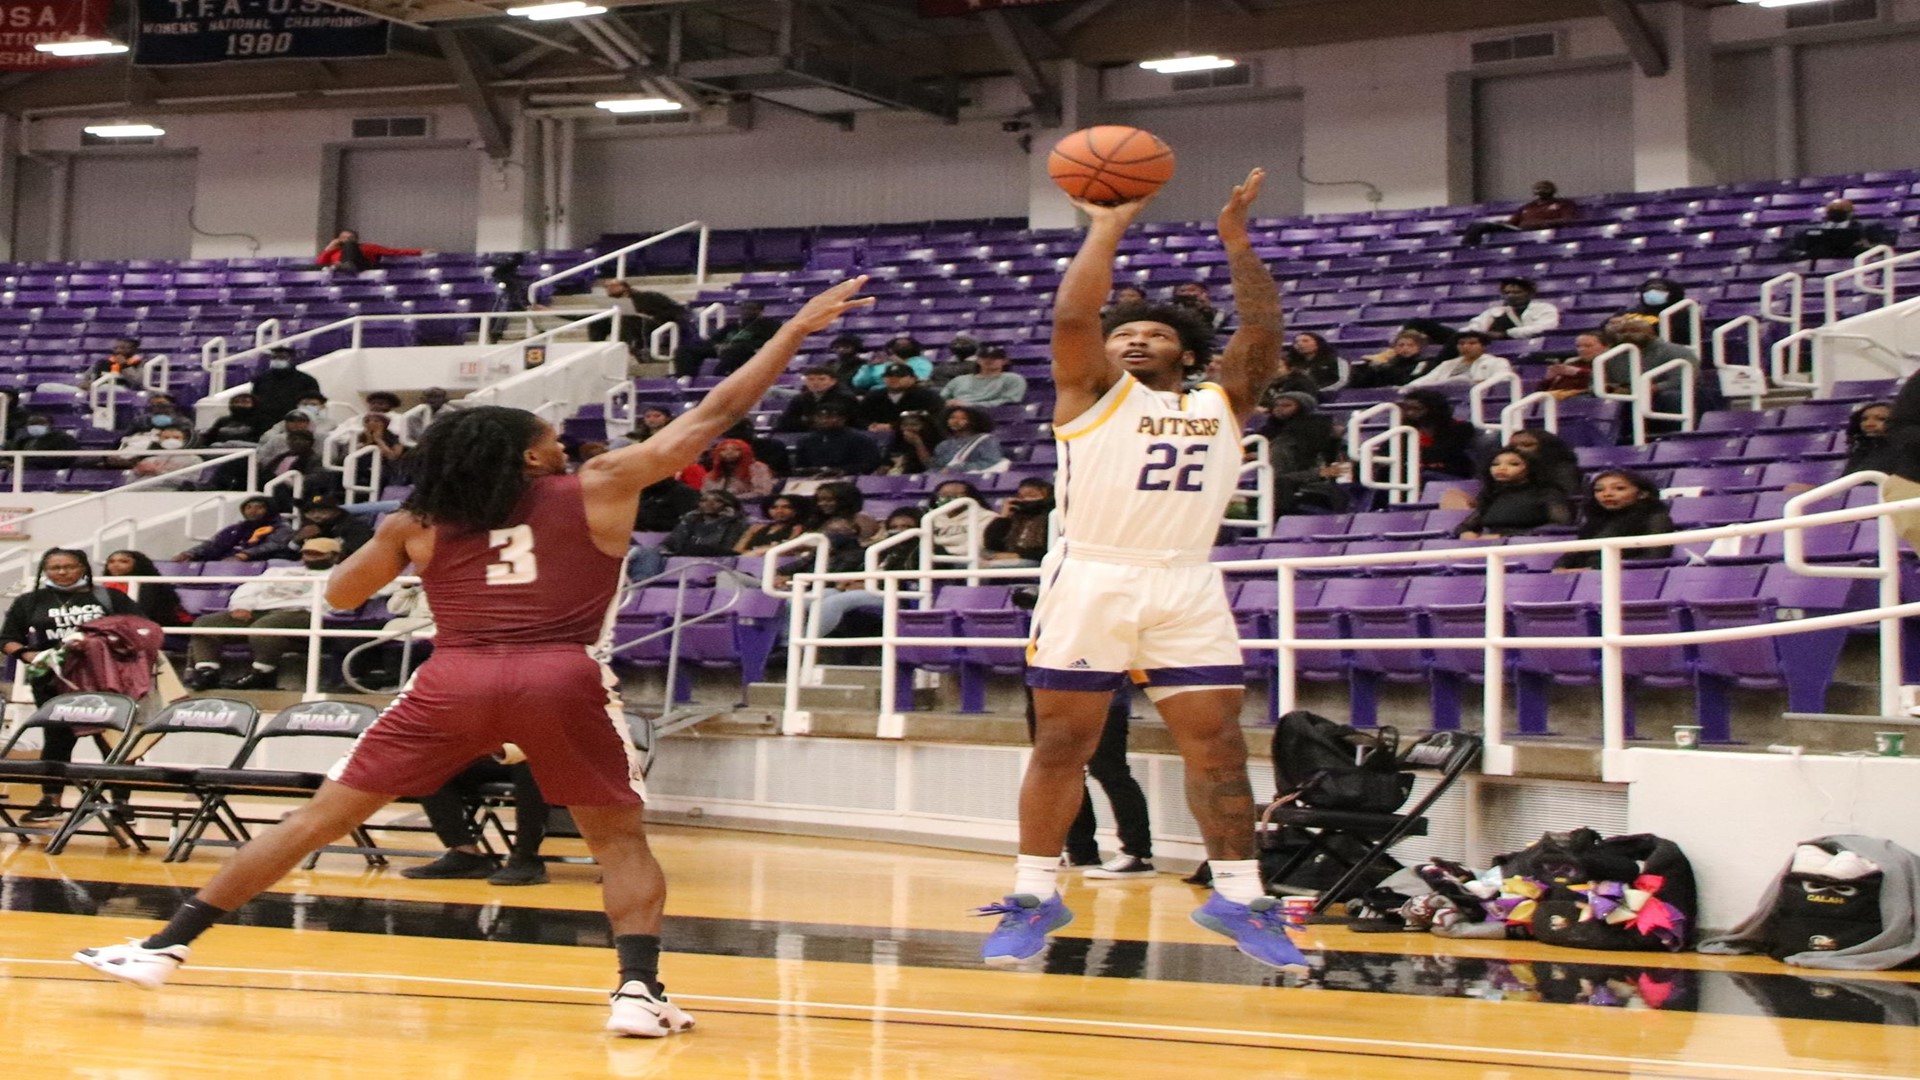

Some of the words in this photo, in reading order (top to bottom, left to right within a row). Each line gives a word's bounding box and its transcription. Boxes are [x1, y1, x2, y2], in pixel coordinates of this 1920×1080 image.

[208, 18, 271, 31] NATIONAL
[225, 33, 292, 55] 1980
[1136, 443, 1208, 491] 22
[486, 524, 537, 585] 3
[48, 604, 105, 617] BLACK
